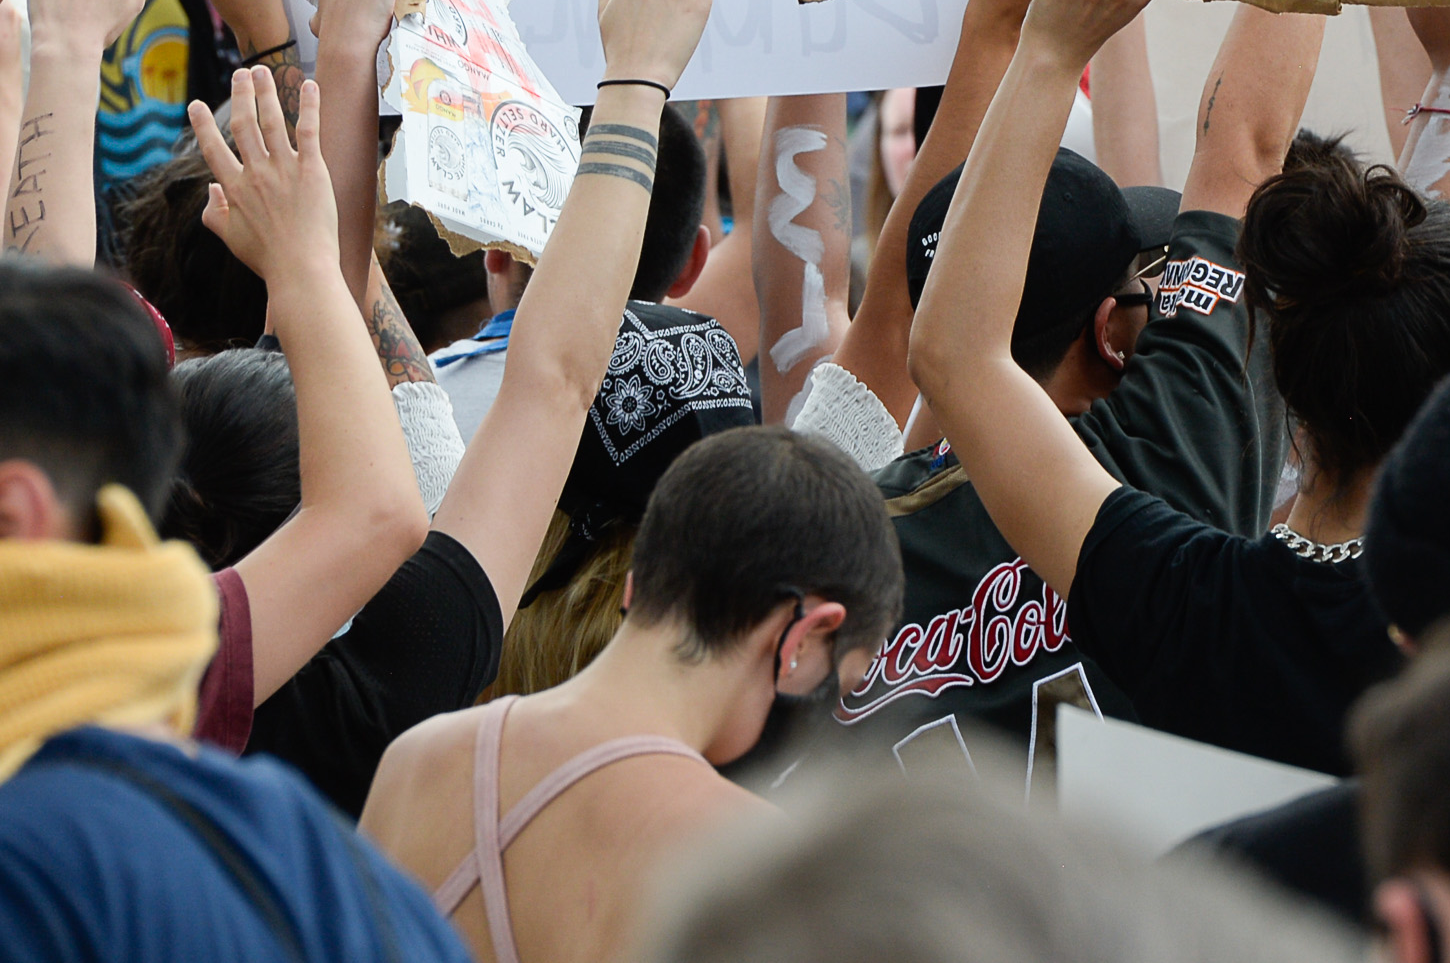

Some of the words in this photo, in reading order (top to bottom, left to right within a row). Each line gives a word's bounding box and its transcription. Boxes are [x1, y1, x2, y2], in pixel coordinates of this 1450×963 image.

[458, 60, 489, 81] MANGO
[496, 107, 523, 157] SELTZER
[529, 112, 566, 153] HARD
[501, 180, 556, 234] LAW
